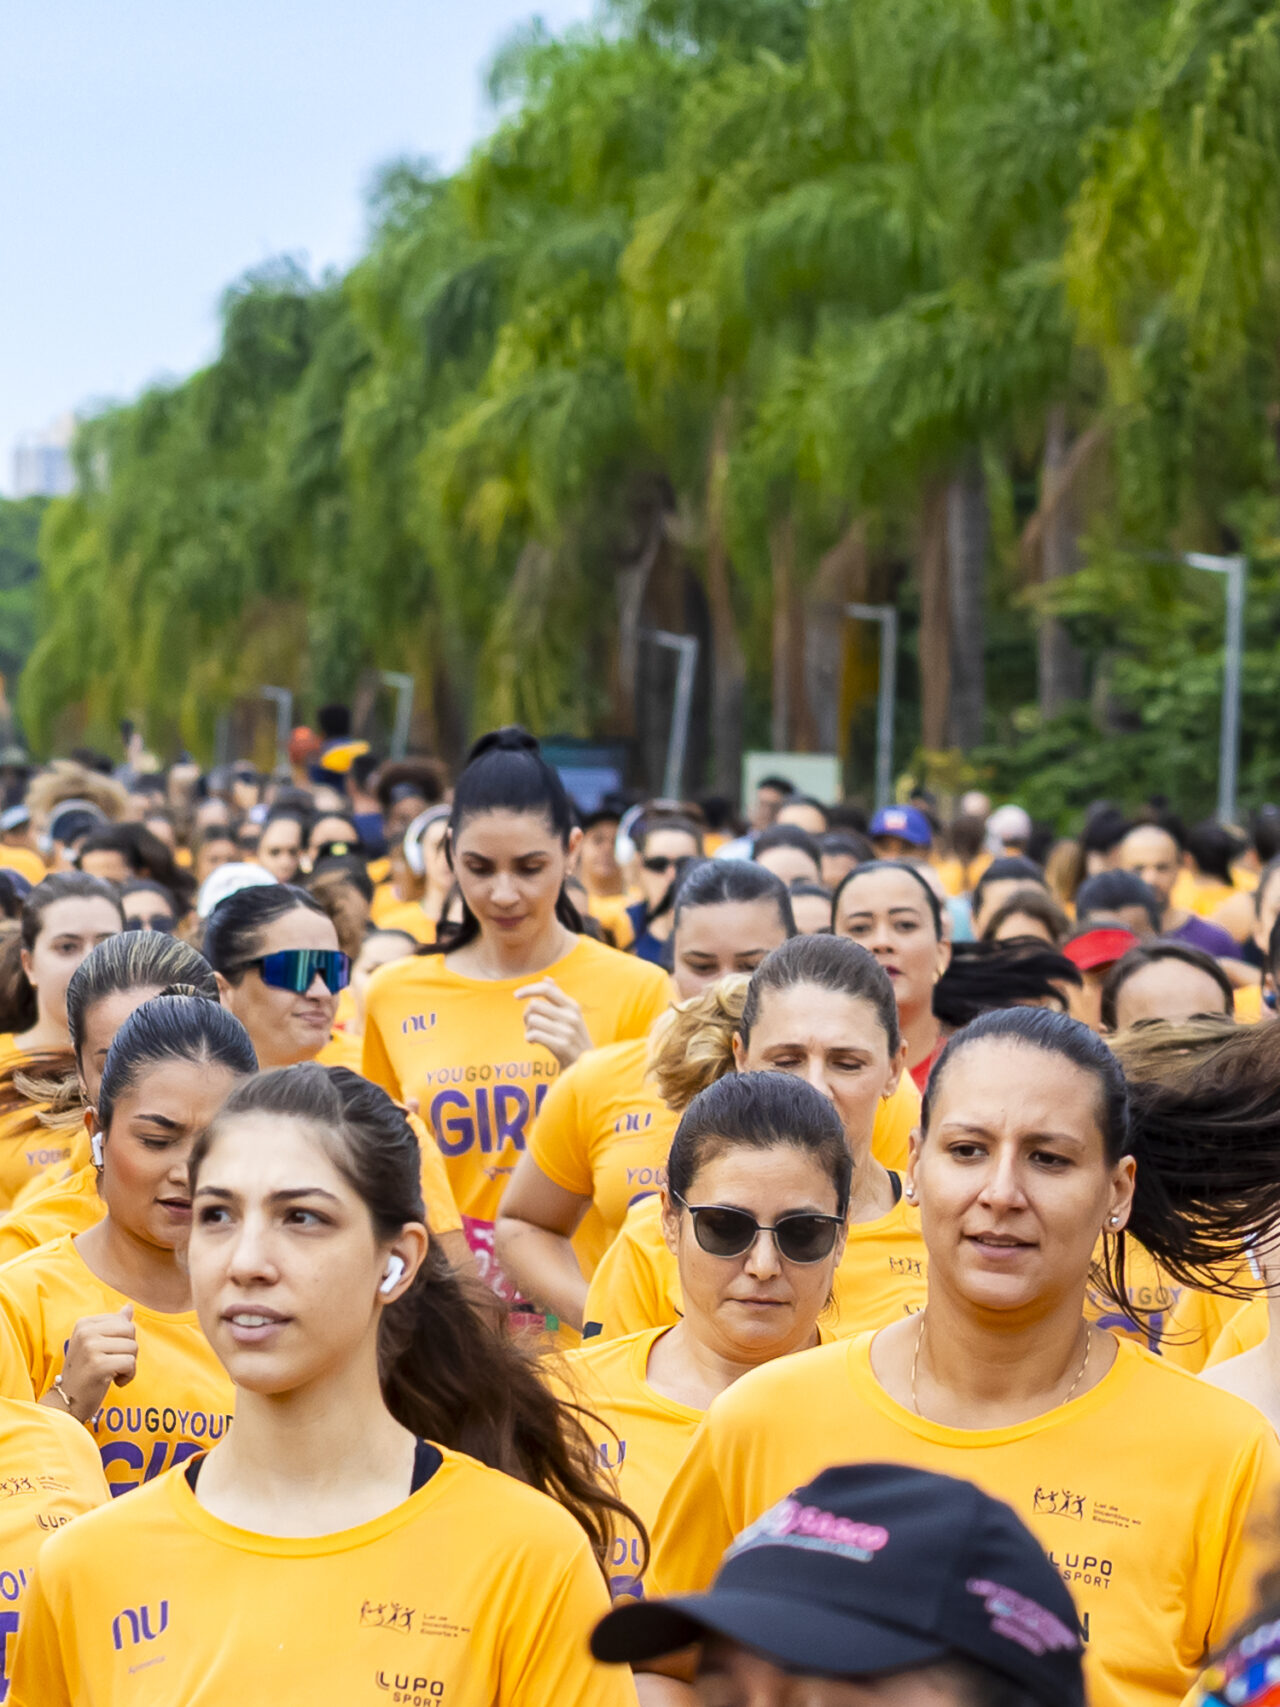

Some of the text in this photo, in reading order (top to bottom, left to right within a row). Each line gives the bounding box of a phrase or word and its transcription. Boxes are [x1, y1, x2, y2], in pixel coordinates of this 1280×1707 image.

[1049, 1552, 1113, 1577] LUPO
[1063, 1570, 1111, 1590] SPORT
[376, 1670, 444, 1697] LUPO
